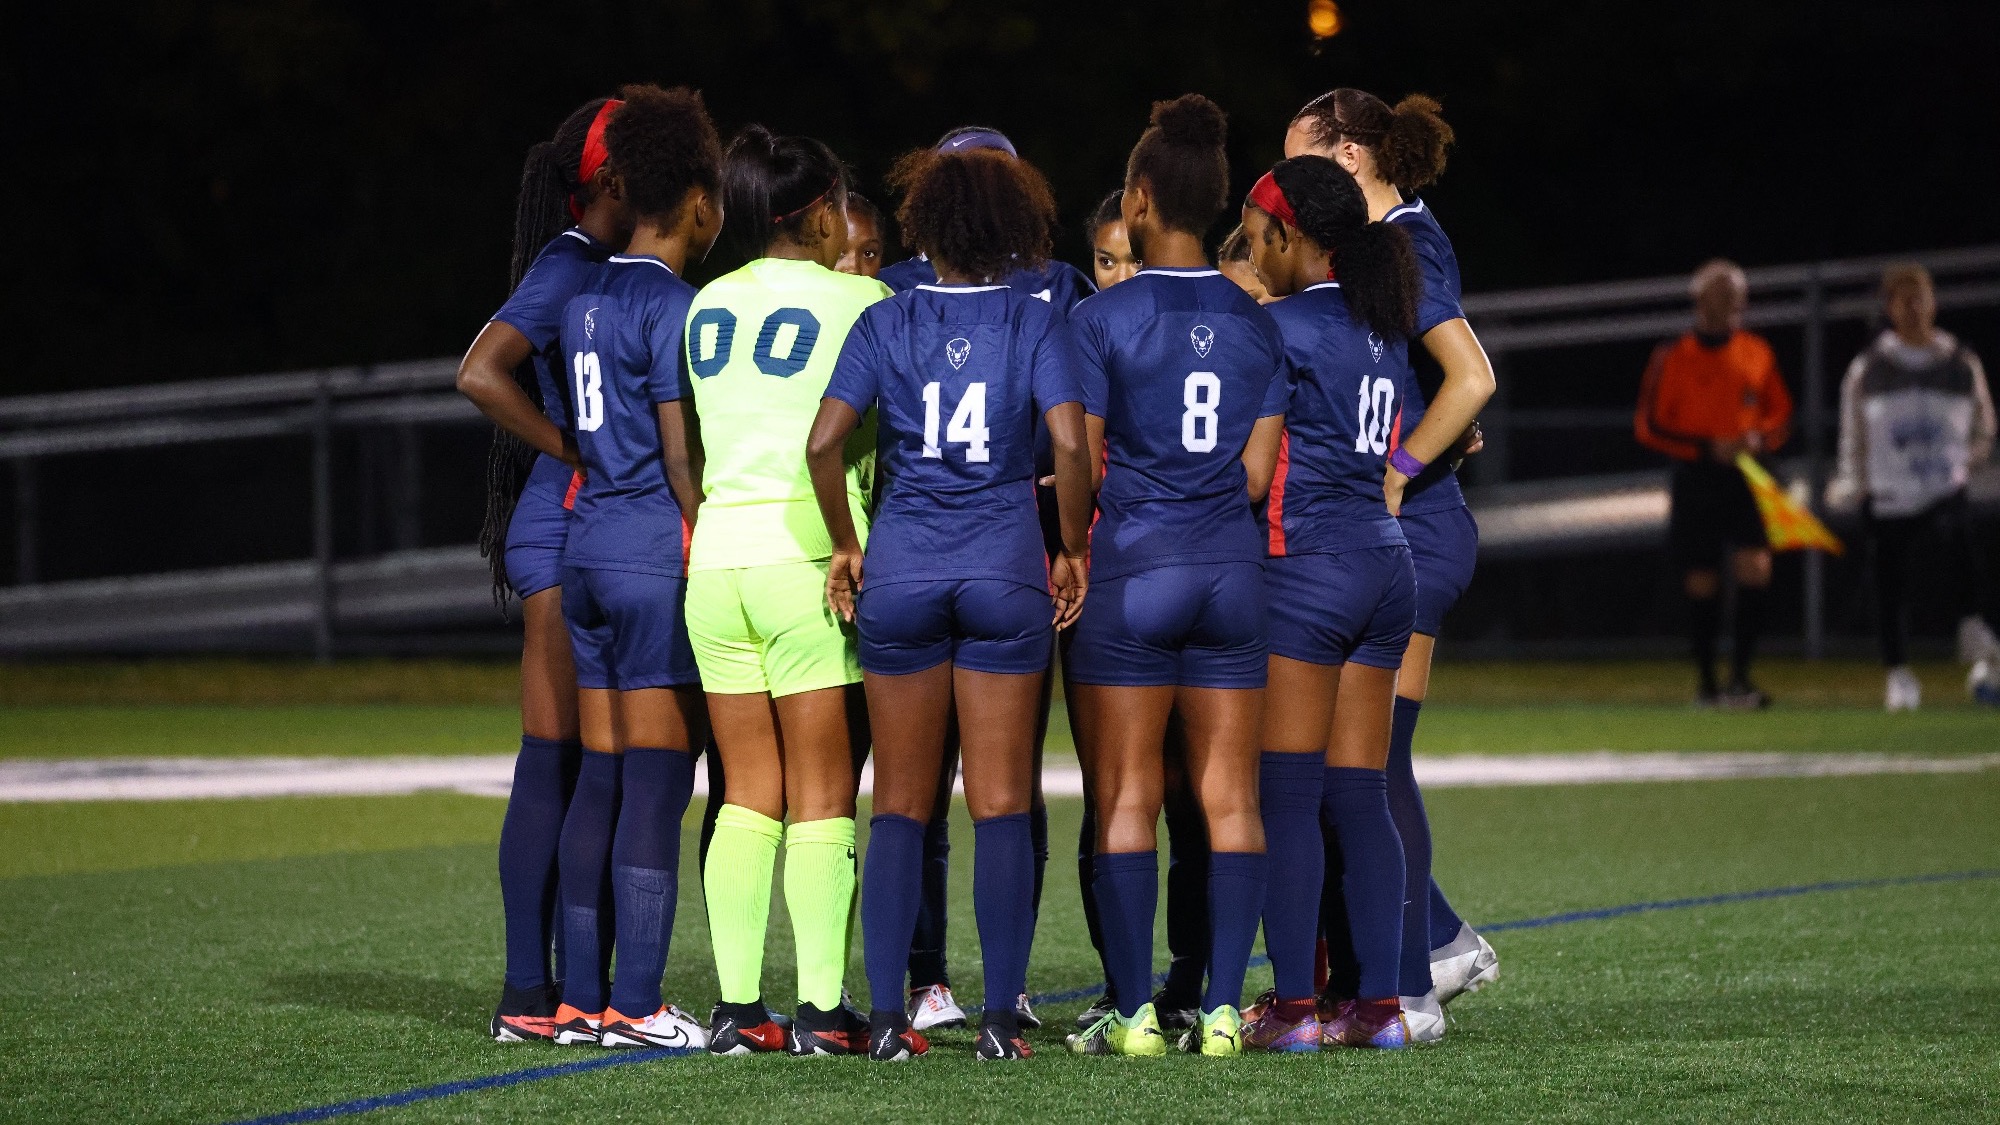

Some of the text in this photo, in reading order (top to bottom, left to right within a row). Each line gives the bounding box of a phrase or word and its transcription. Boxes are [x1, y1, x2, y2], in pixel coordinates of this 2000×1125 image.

[688, 307, 821, 380] 00
[574, 352, 603, 432] 13
[922, 382, 990, 463] 14
[1181, 371, 1221, 454] 8
[1355, 374, 1395, 456] 10
